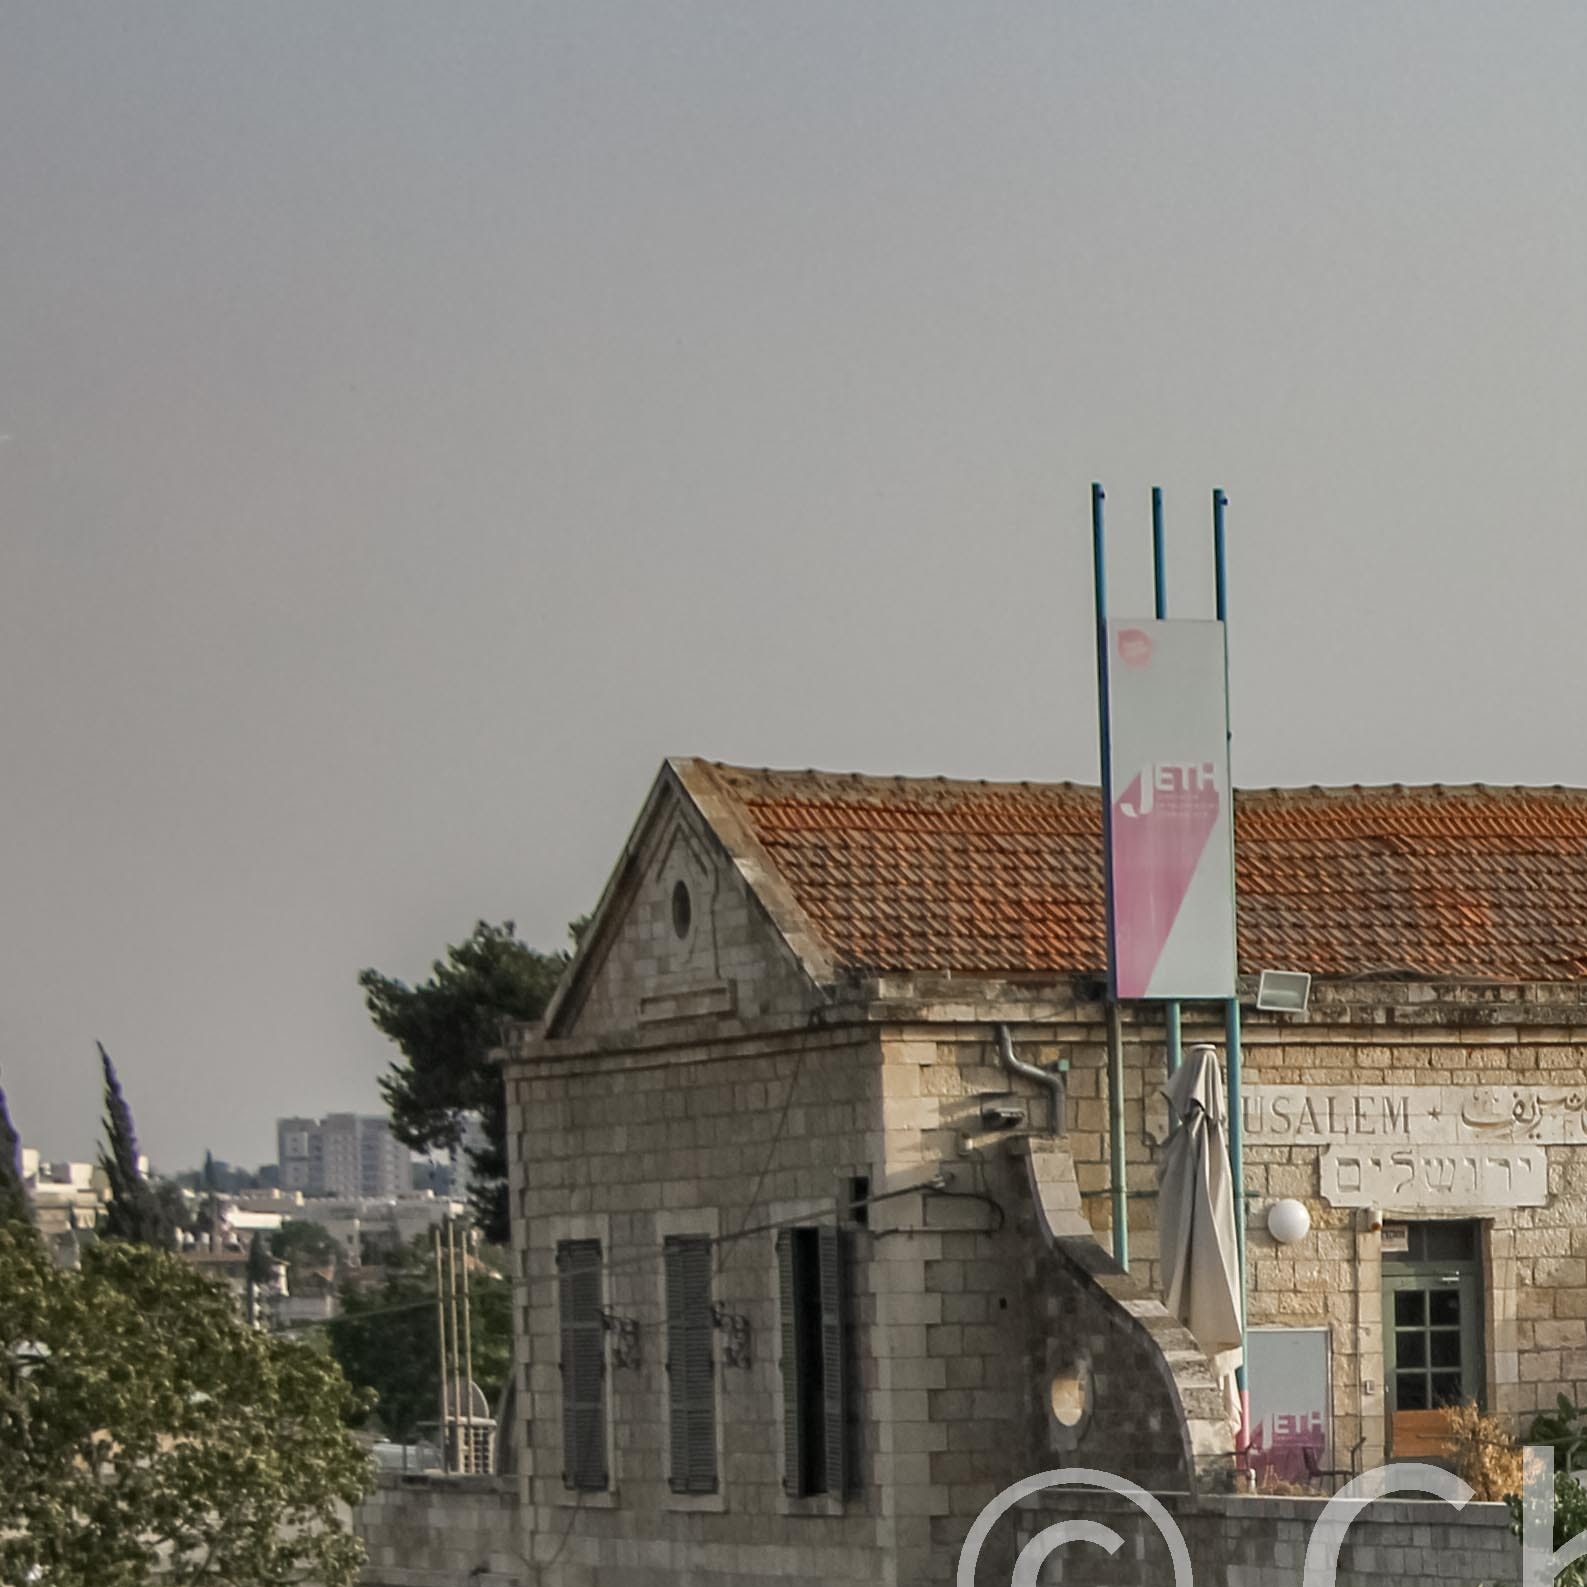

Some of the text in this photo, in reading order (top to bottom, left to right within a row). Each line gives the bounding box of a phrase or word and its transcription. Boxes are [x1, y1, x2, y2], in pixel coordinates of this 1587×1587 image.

[1120, 762, 1218, 817] JETH
[1242, 1095, 1410, 1136] USALEM
[1336, 1150, 1532, 1194] ירושלים
[1250, 1411, 1324, 1455] JETH
